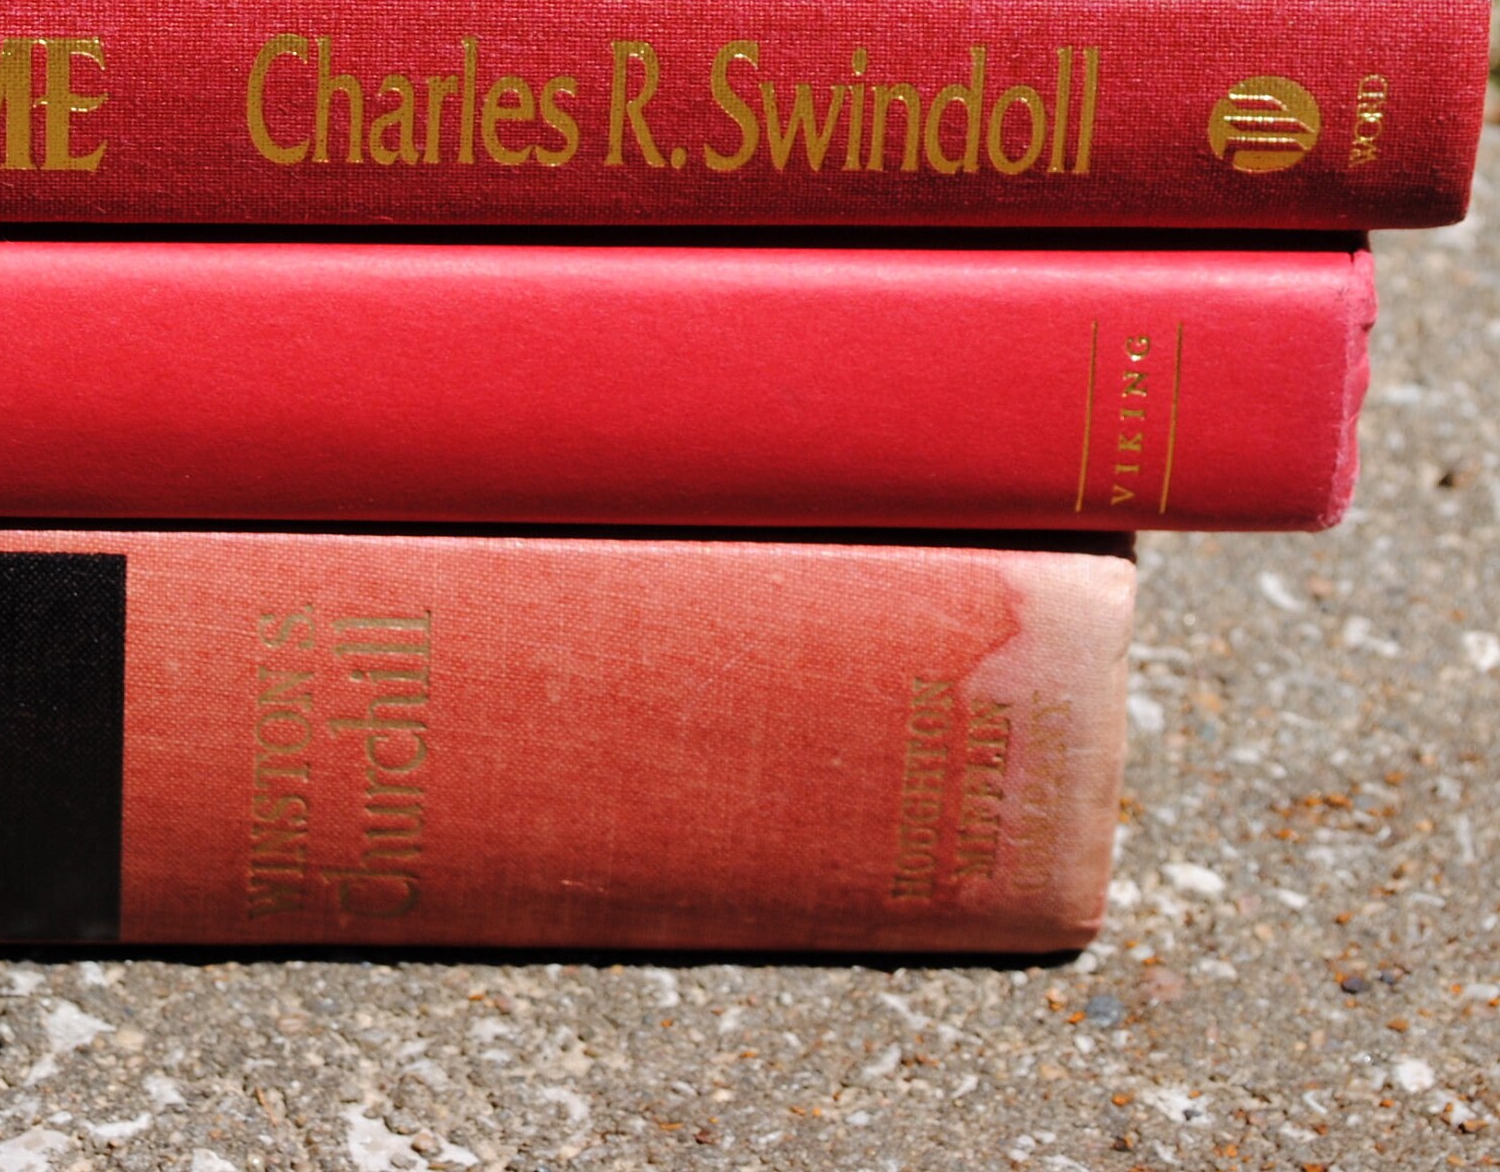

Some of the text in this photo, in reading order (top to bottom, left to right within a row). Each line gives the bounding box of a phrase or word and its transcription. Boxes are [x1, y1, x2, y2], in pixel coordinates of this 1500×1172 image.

[246, 33, 1099, 175] Charles R. Swindoll
[1348, 74, 1388, 168] WORD
[1110, 335, 1150, 505] VIKING
[246, 604, 315, 920] WINSTON S.
[320, 609, 432, 919] Churchill
[891, 676, 953, 899] HOUGHTON
[955, 699, 1011, 880] MIFFLIN
